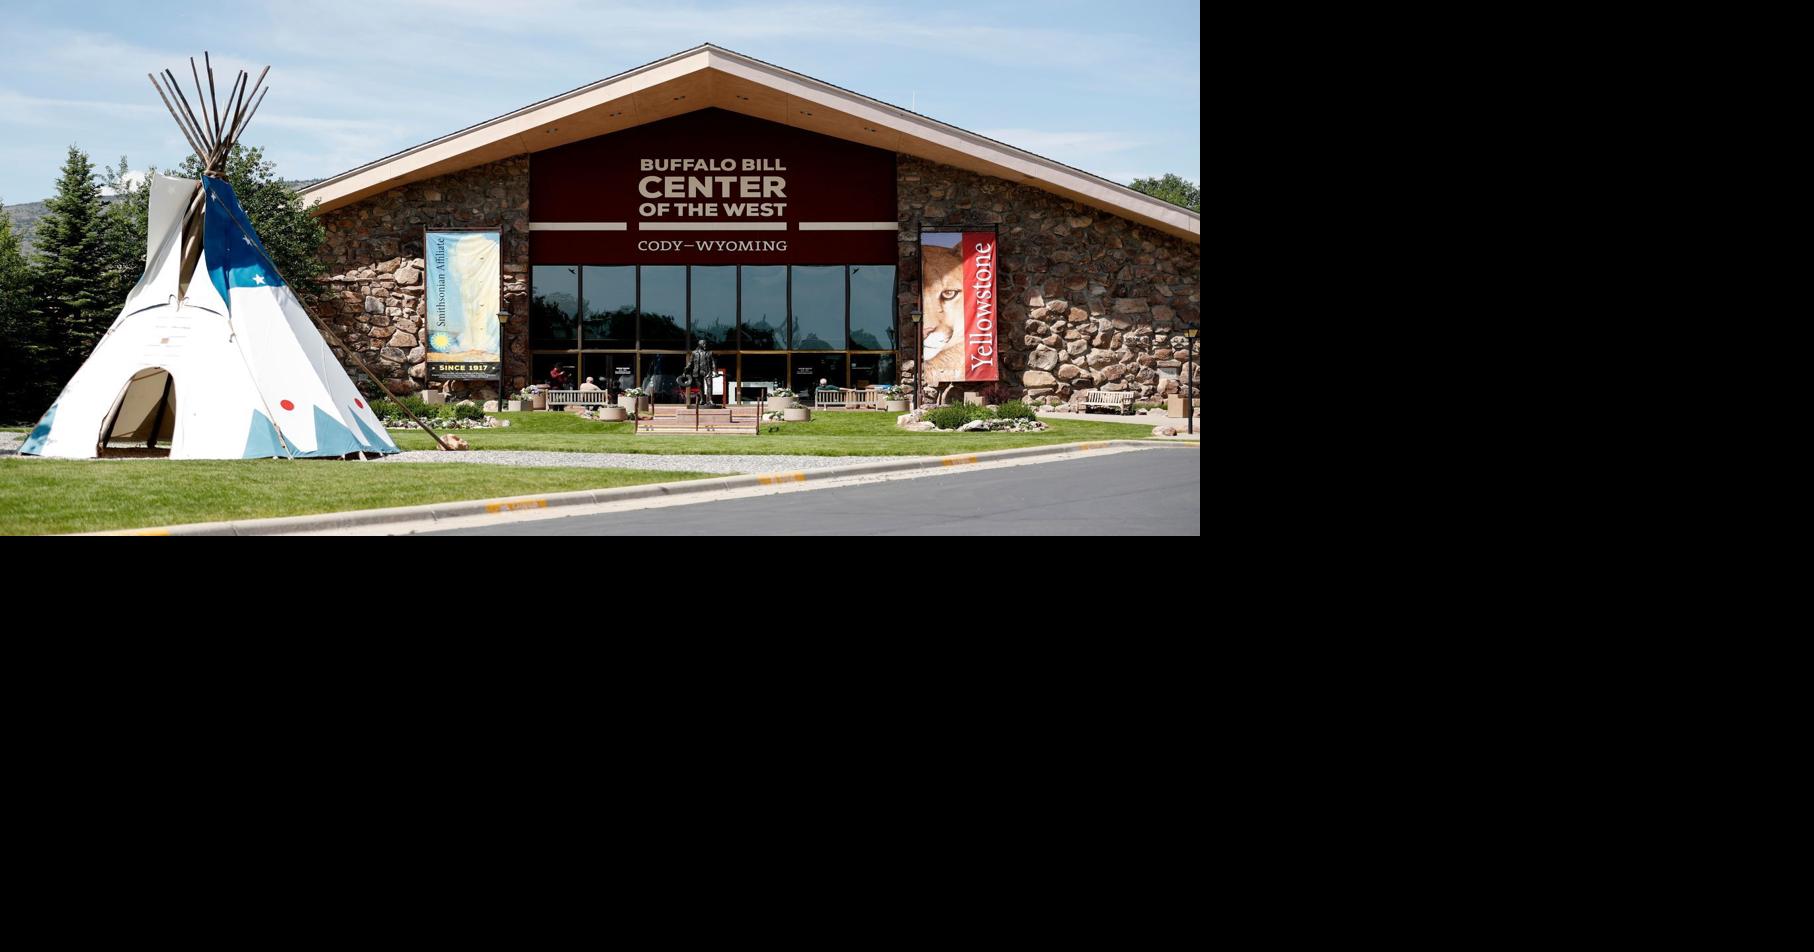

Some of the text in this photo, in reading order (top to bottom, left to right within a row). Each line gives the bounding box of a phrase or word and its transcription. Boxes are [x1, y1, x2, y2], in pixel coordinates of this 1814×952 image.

[640, 158, 787, 172] BUFFALO BILL
[638, 175, 788, 199] CENTER
[638, 202, 788, 217] OF THE WEST
[435, 237, 446, 327] Smithsonian Affiliate
[969, 242, 993, 371] Yellowstone
